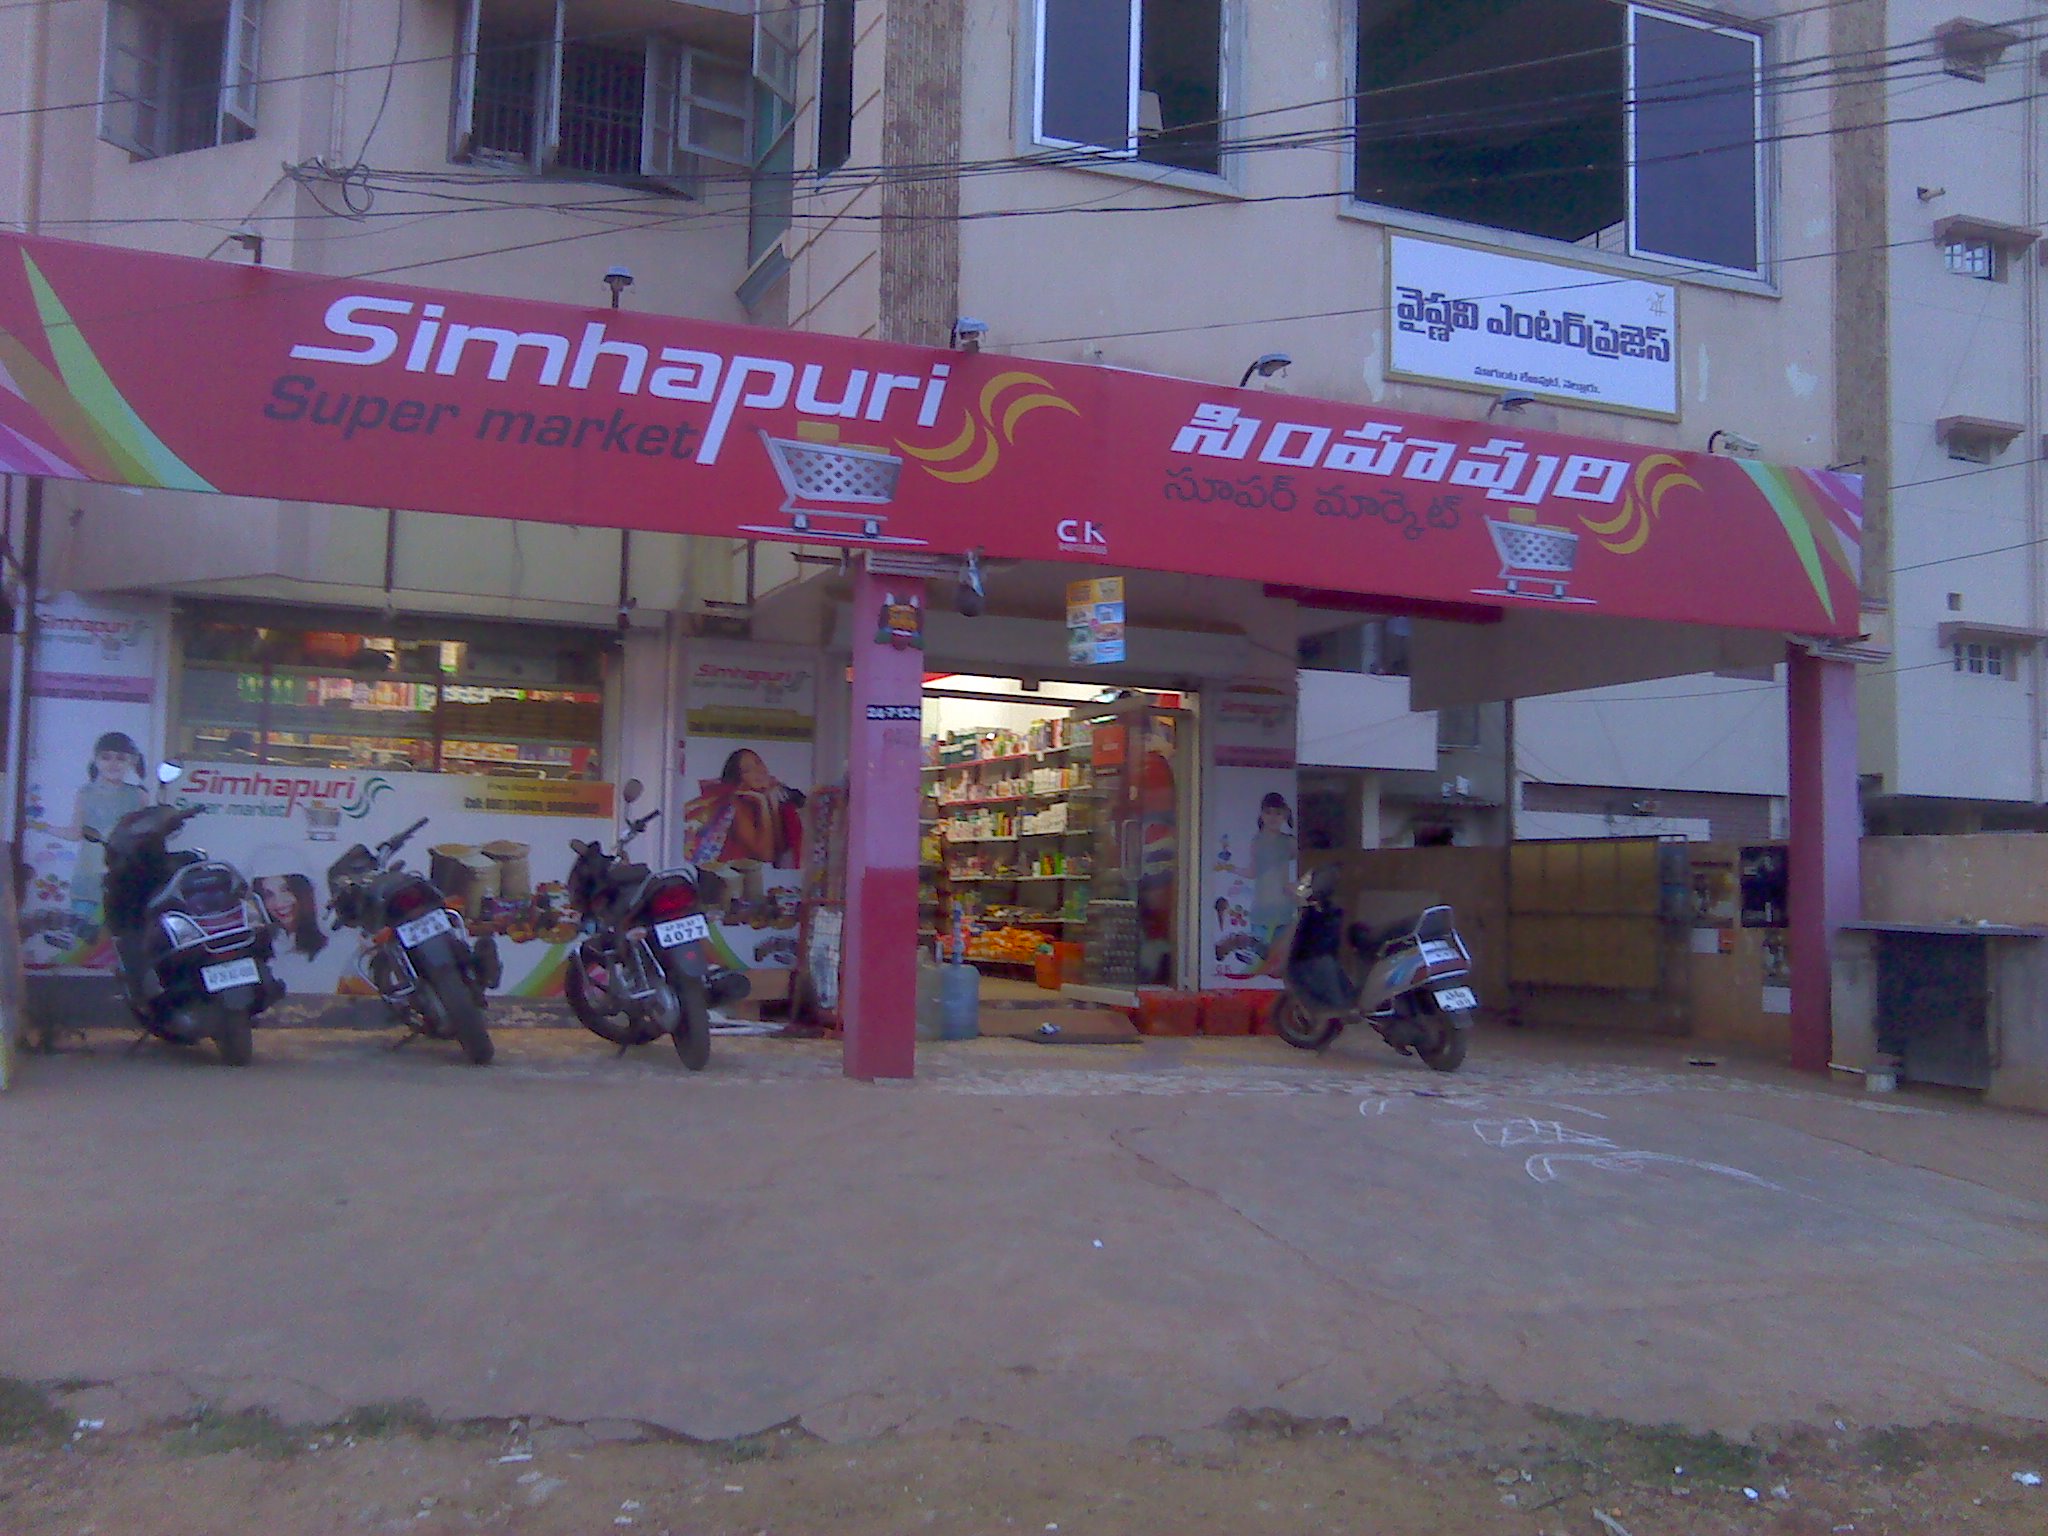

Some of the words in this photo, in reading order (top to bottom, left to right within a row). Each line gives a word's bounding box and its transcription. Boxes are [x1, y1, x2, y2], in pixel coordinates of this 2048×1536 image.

[263, 374, 460, 440] Super
[477, 407, 697, 460] market
[290, 294, 951, 465] Simhapuri
[1164, 466, 1297, 512] సూపర్
[1313, 484, 1463, 541] మార్కెట్
[181, 768, 357, 818] Simhapuri
[663, 925, 704, 943] 4077
